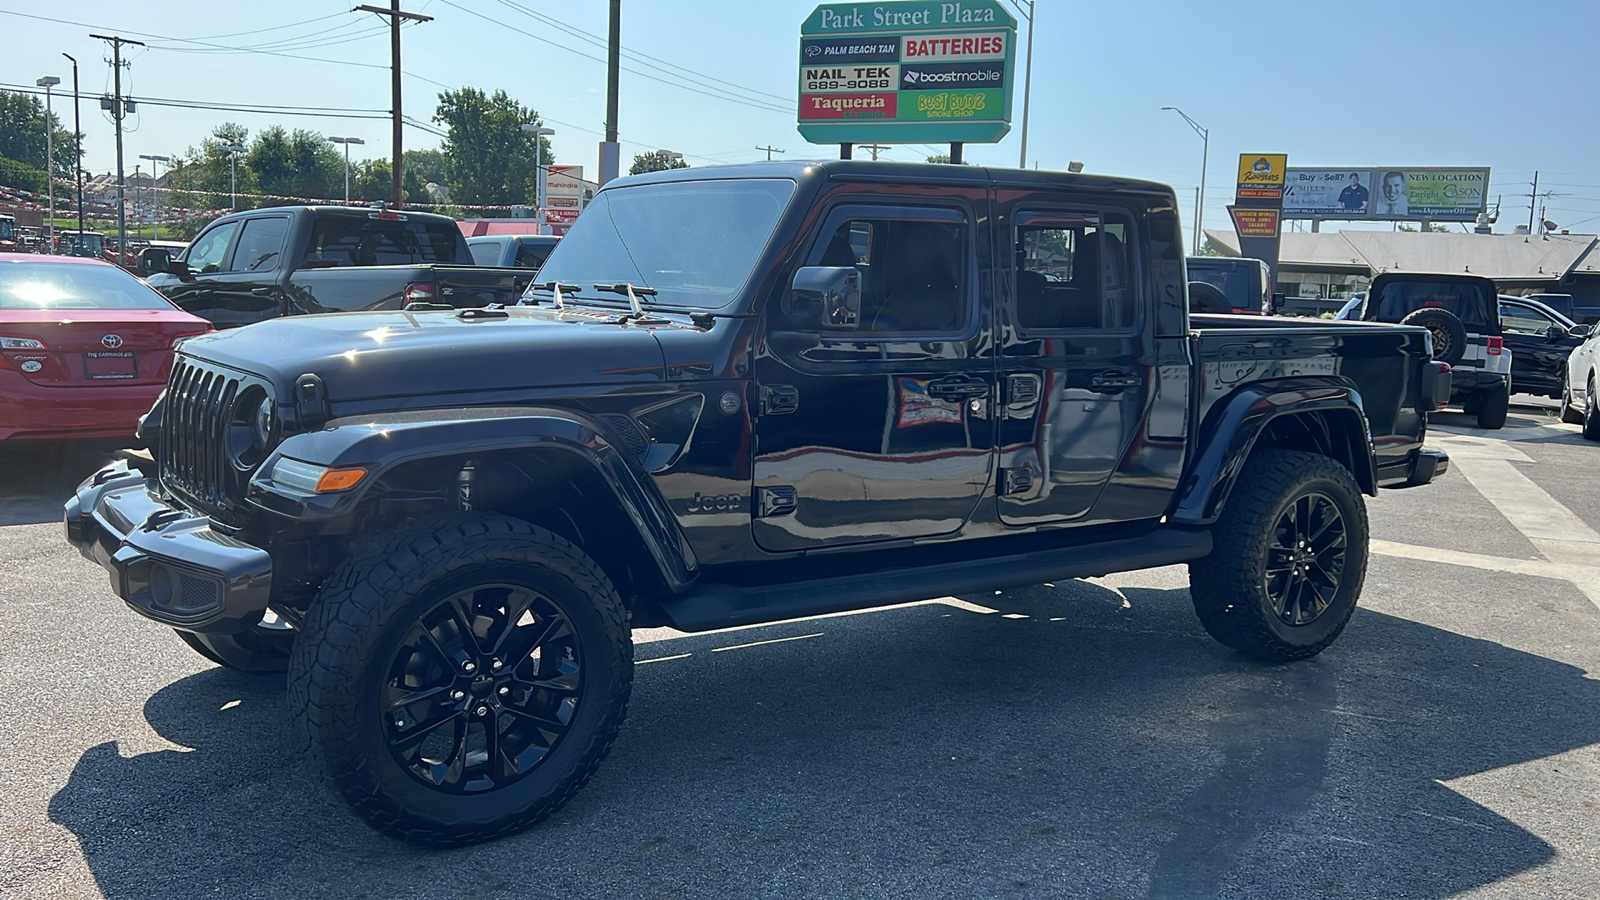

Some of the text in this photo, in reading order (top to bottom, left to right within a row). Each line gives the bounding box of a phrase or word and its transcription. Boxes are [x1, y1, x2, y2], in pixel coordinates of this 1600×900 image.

[821, 4, 995, 29] Park Street Plaza
[824, 44, 895, 55] PALM BEACH TAN
[906, 37, 1003, 57] BATTERIES
[807, 67, 891, 80] NAIL TEK
[920, 70, 1000, 83] boostmobile
[808, 80, 890, 89] 689-9088
[1244, 171, 1280, 182] Roosters
[1299, 173, 1316, 182] Buy
[1324, 173, 1345, 181] Sell?
[1410, 190, 1439, 199] Enright
[687, 491, 741, 512] Jeep
